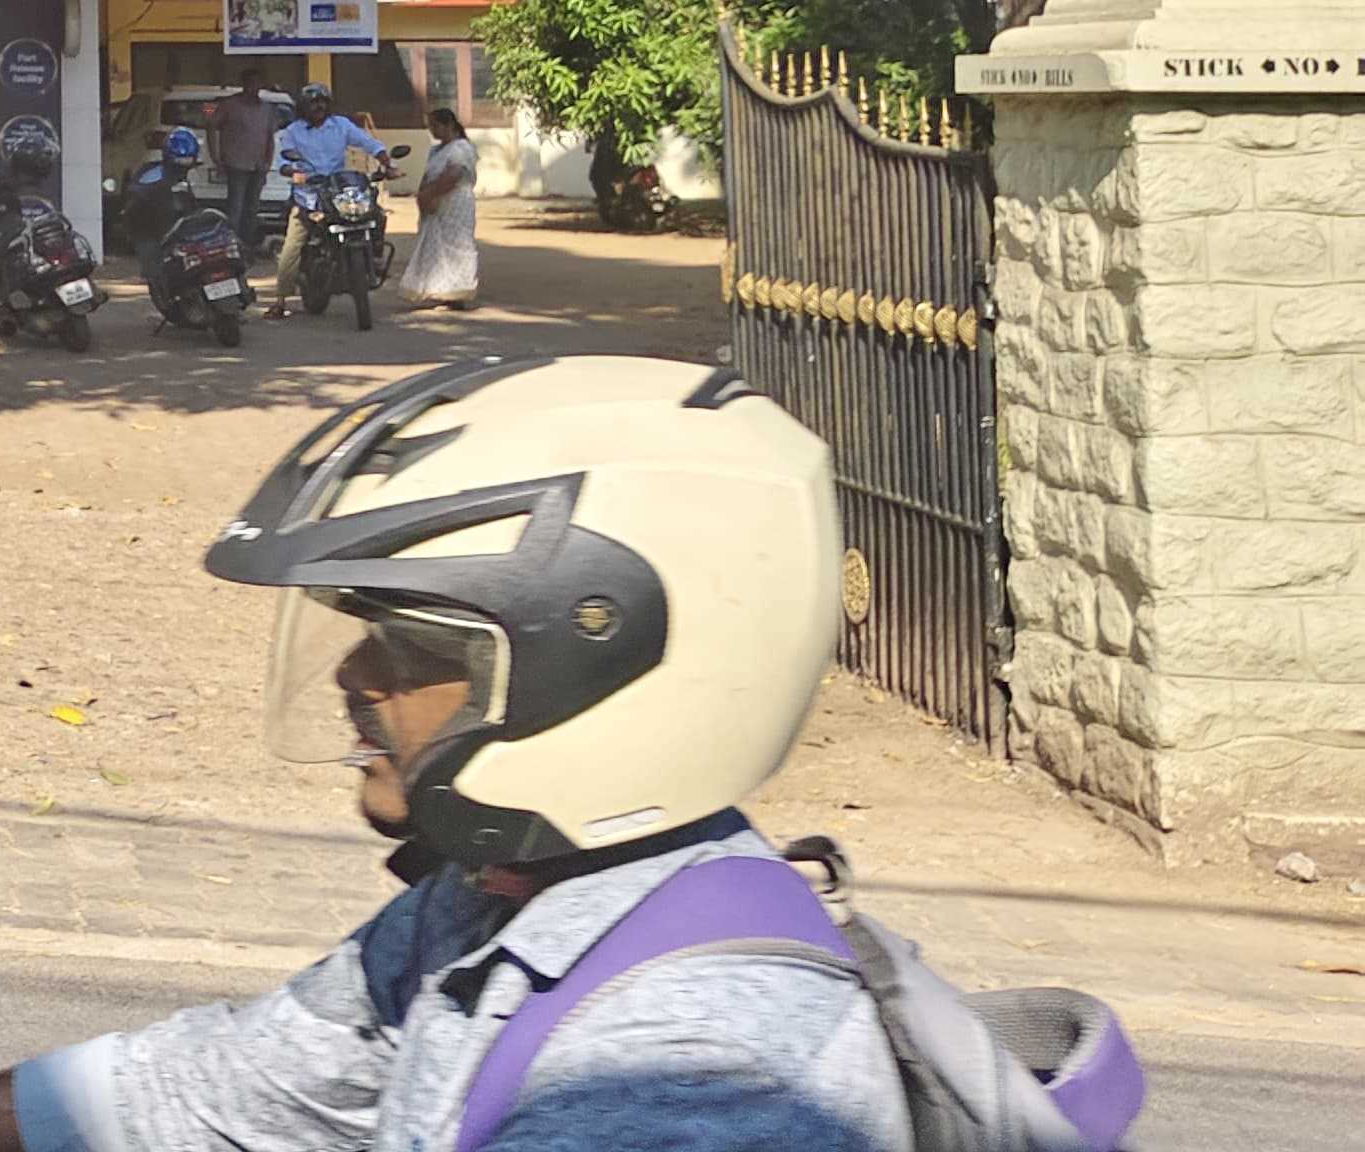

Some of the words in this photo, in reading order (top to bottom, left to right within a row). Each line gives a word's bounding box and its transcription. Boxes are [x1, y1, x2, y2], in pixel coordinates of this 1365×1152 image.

[1163, 57, 1244, 77] STICK
[1283, 56, 1320, 76] NO
[1044, 69, 1074, 87] BILLS
